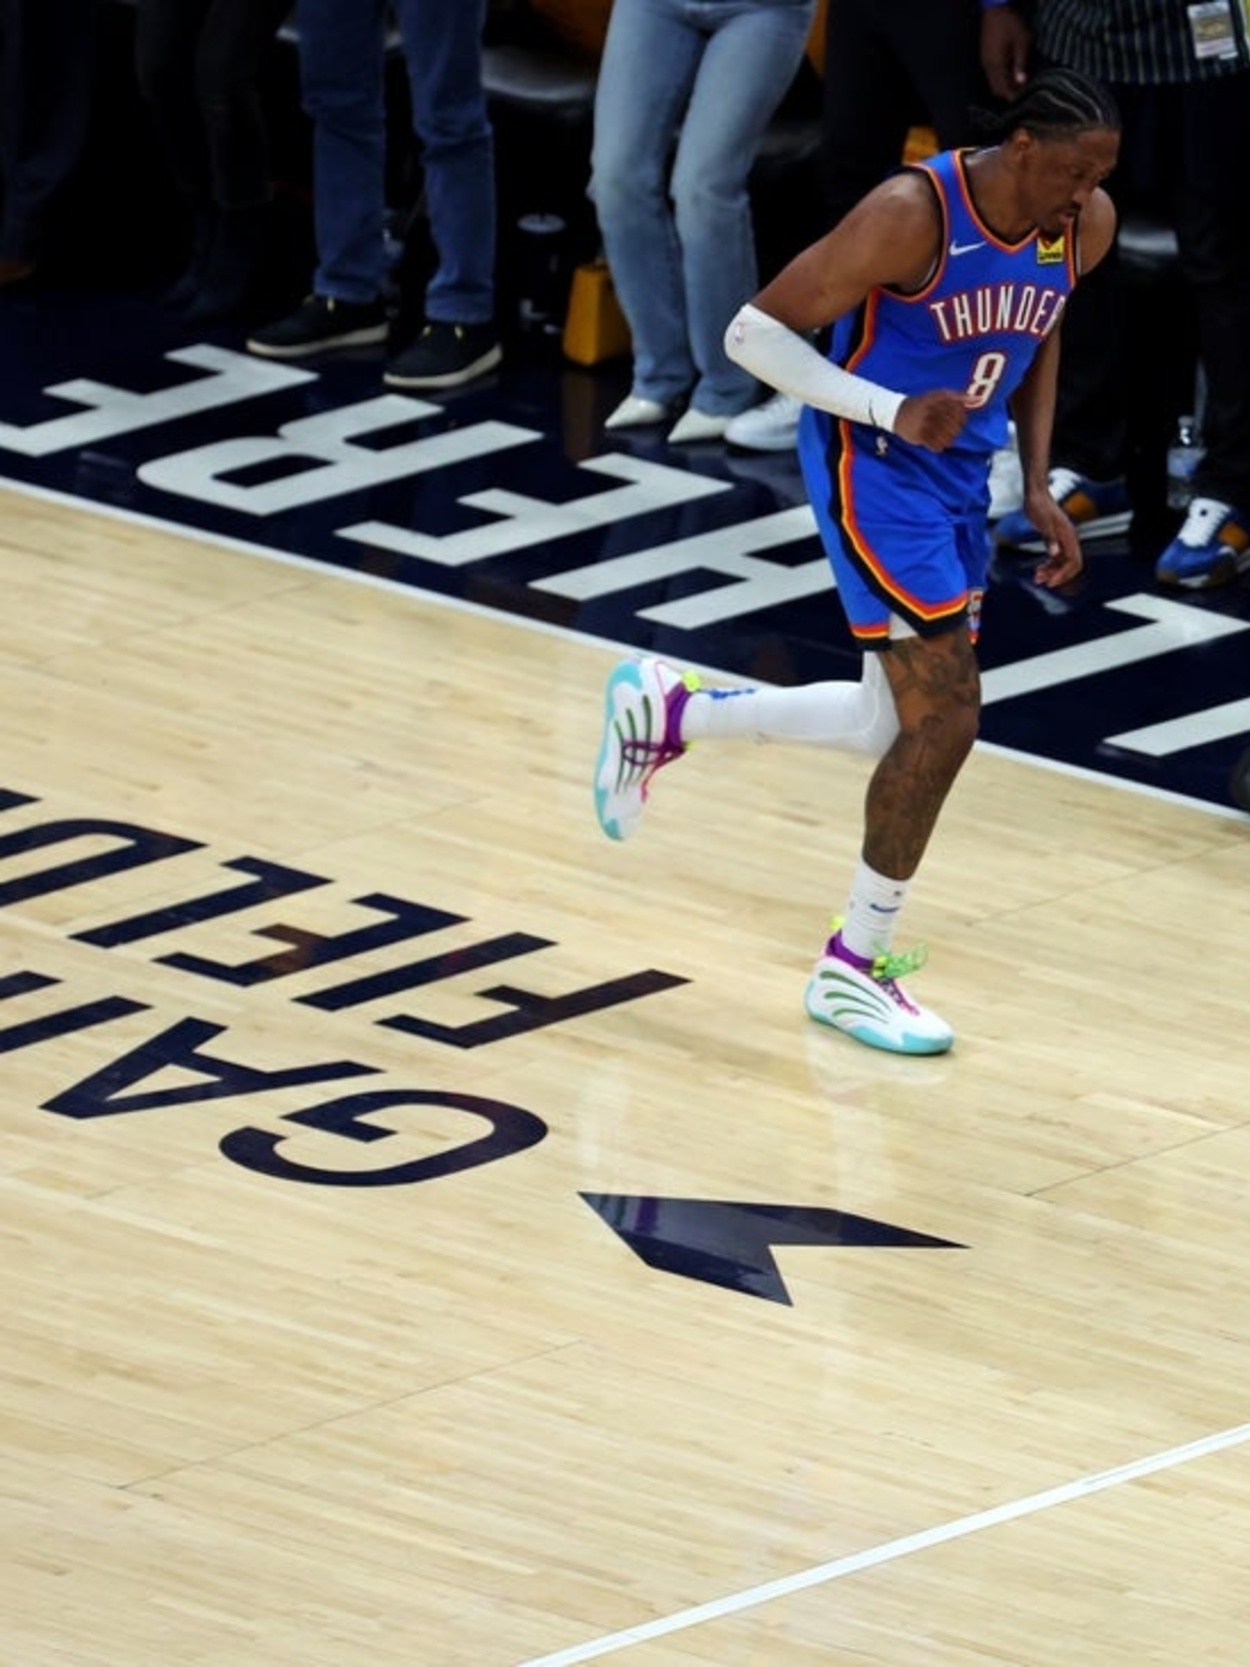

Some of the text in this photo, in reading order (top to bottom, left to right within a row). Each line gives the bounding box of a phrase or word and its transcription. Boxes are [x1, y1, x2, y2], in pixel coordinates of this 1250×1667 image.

[0, 343, 838, 630] HERE
[964, 352, 1006, 409] 8
[0, 787, 693, 1049] FIELD
[0, 969, 549, 1187] GAI
